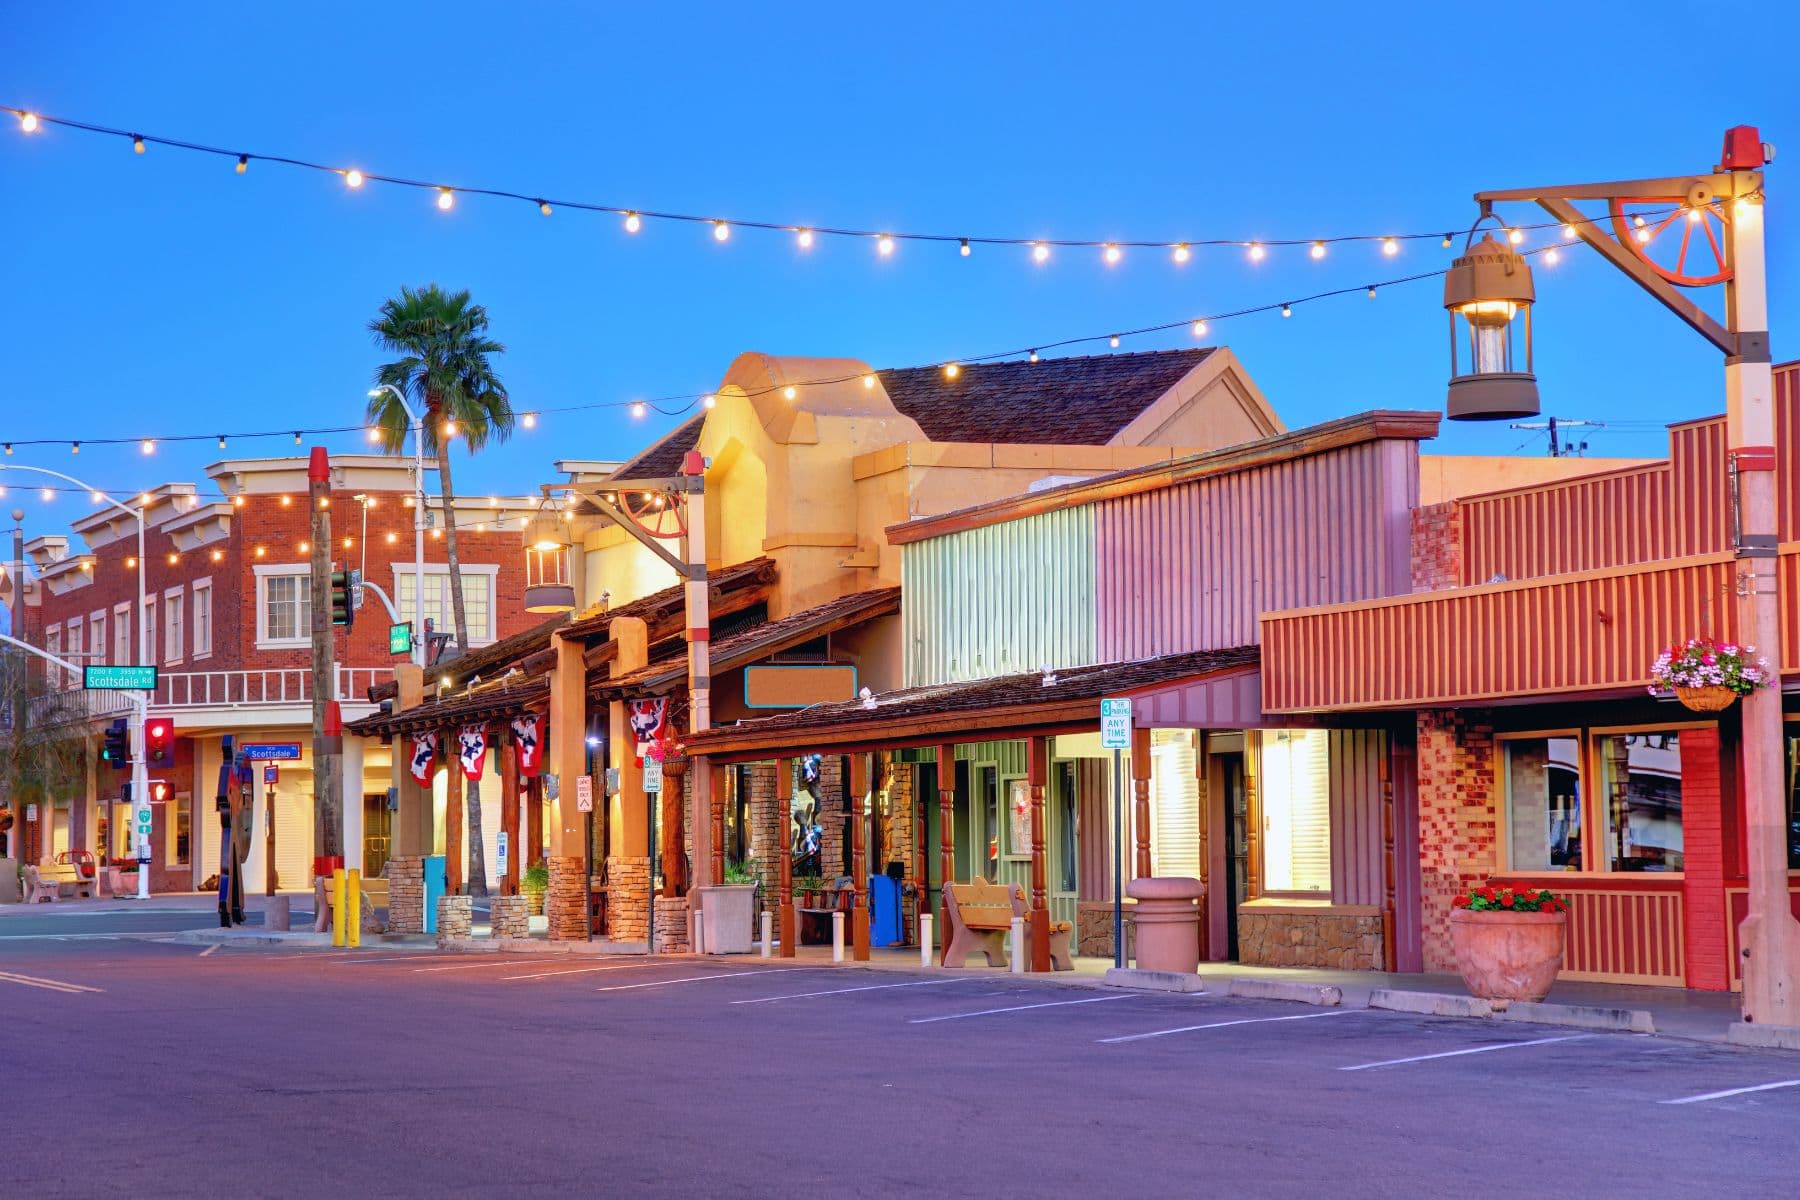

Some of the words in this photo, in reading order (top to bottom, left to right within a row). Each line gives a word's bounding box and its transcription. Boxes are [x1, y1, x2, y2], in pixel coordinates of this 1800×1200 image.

[89, 676, 139, 687] Scottsdale
[1103, 702, 1110, 714] 3
[1108, 719, 1125, 727] ANY
[1107, 729, 1125, 737] TIME
[645, 757, 650, 767] 3
